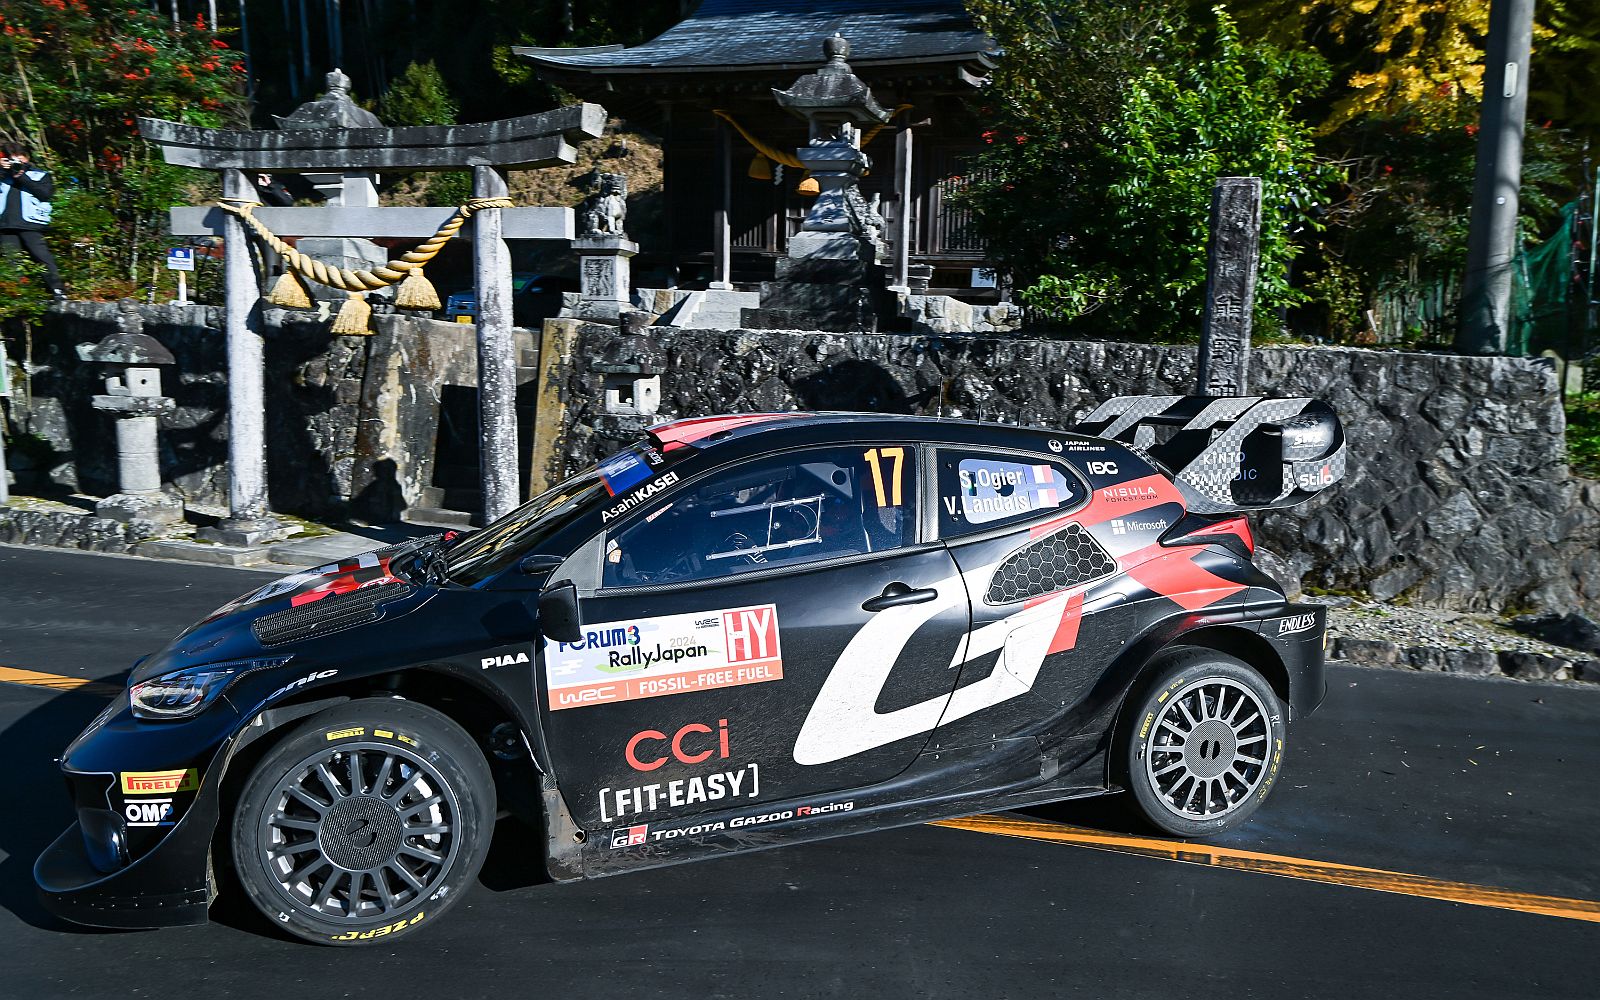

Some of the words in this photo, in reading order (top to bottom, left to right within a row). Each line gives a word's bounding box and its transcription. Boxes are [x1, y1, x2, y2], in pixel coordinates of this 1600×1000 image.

[863, 446, 905, 508] 17
[1299, 464, 1334, 487] Stilo
[1103, 486, 1157, 499] NISULA
[1126, 518, 1169, 532] Microsoft
[1278, 611, 1317, 634] ENDLESS
[669, 635, 697, 648] 2024
[724, 608, 772, 663] HY
[480, 652, 530, 670] PIAA
[639, 669, 734, 695] FOSSIL-FREE
[737, 665, 774, 681] FUEL
[559, 685, 617, 705] WRC
[126, 772, 192, 790] PIRELLI
[125, 803, 174, 822] OMP
[651, 821, 725, 842] TOYOTA
[796, 801, 854, 818] Racing
[612, 832, 646, 847] GR
